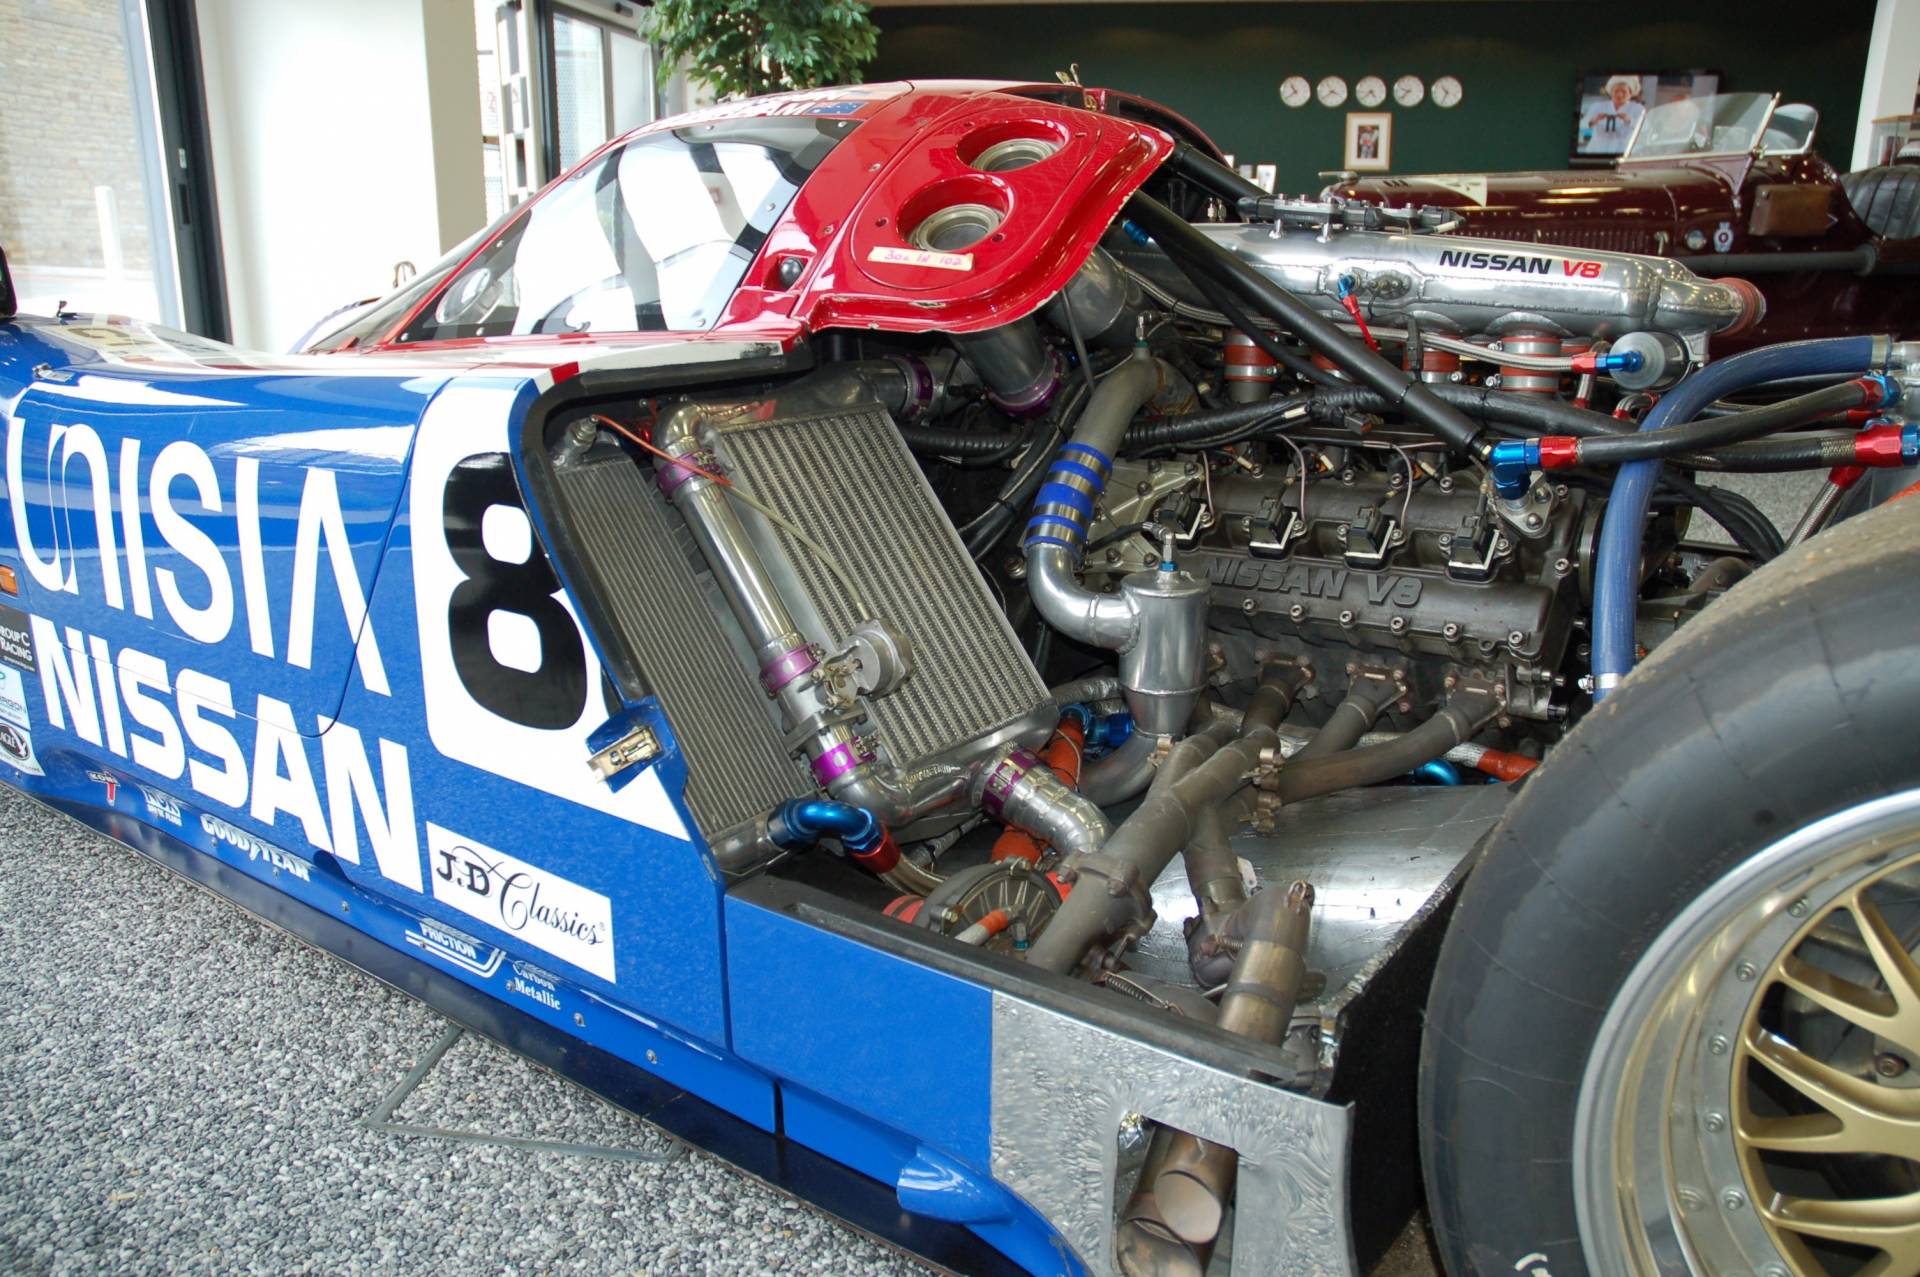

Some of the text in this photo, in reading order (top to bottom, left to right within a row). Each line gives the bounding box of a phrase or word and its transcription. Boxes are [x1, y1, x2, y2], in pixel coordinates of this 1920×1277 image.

[1439, 250, 1602, 279] NISSAN V8
[442, 452, 588, 731] 8
[1203, 557, 1423, 609] NISSAN V8
[30, 614, 425, 894] NISSAN
[200, 814, 311, 882] GOODYEAR
[499, 871, 604, 946] Classics
[418, 920, 477, 960] FRICTION
[512, 960, 556, 992] Carbon
[514, 976, 561, 1010] Metallic
